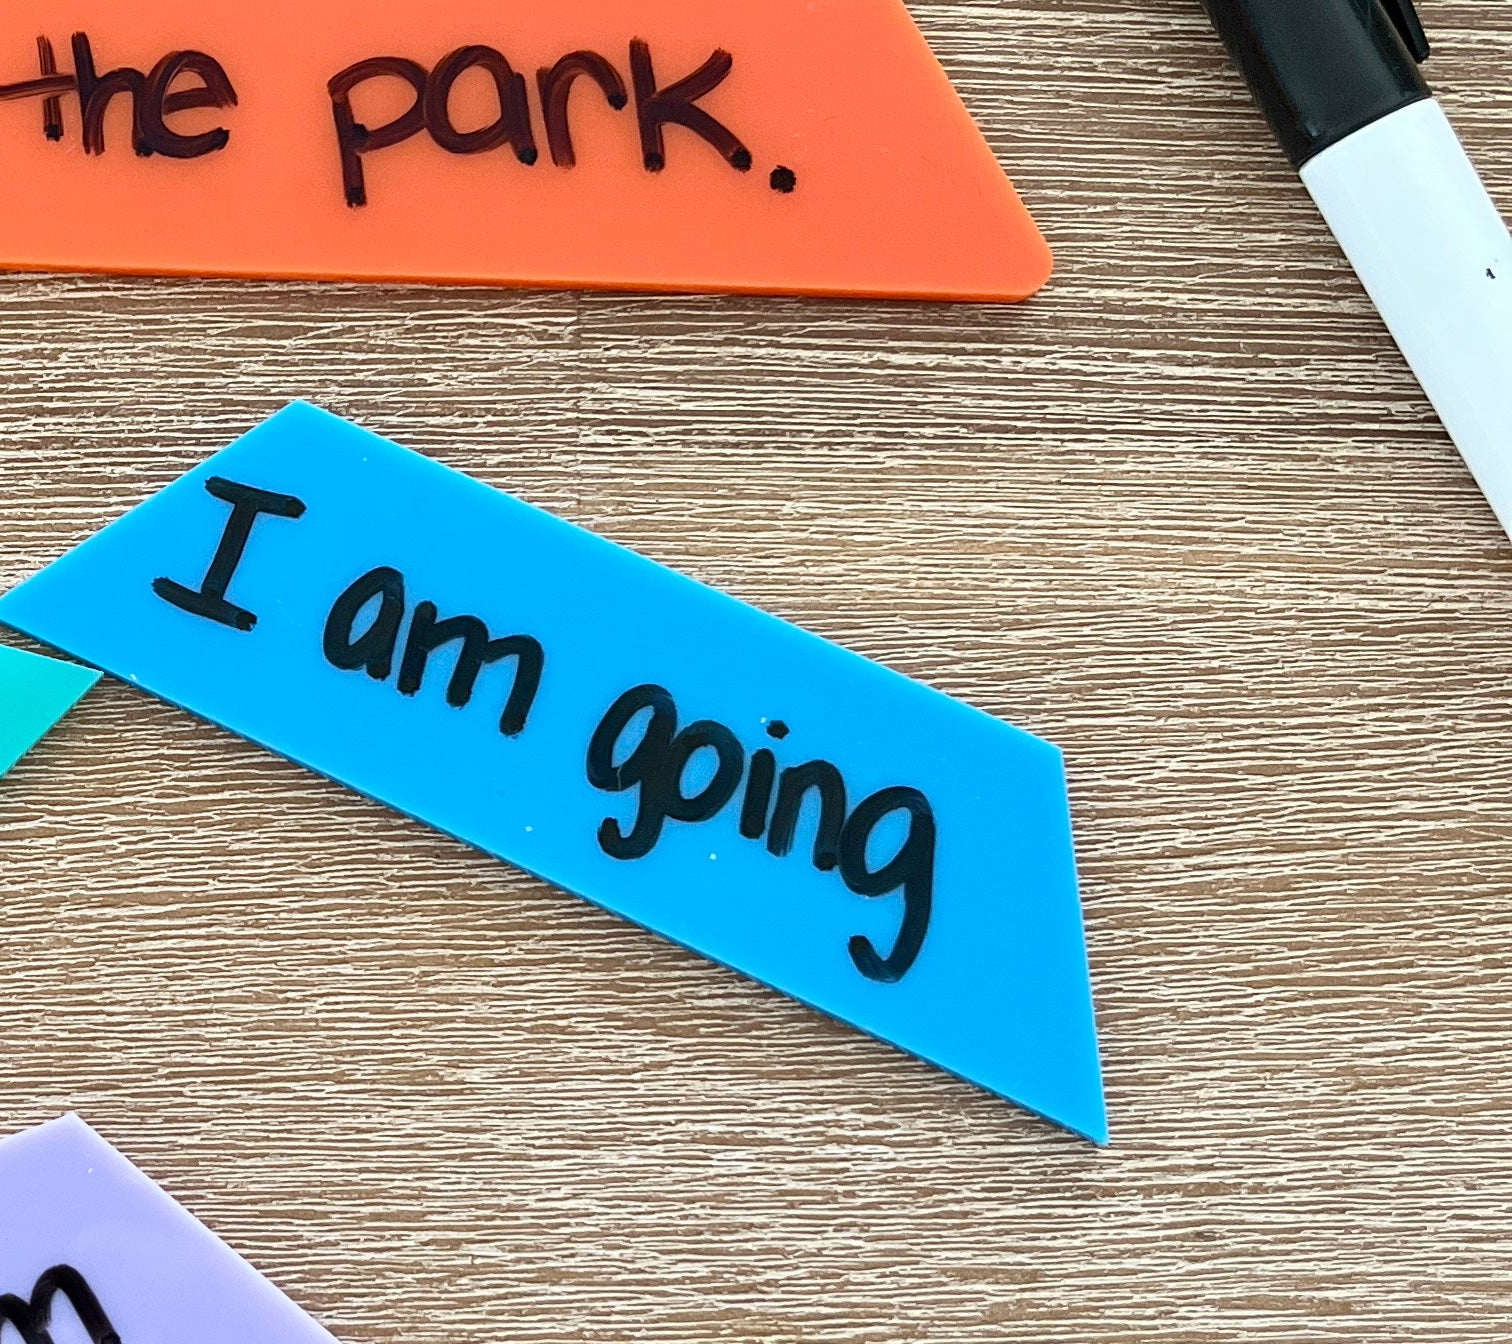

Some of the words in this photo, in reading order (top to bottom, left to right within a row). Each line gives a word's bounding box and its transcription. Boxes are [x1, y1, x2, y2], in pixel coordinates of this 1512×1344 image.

[328, 40, 796, 208] park.
[152, 476, 307, 632] I
[323, 566, 544, 736] am
[586, 684, 936, 981] going
